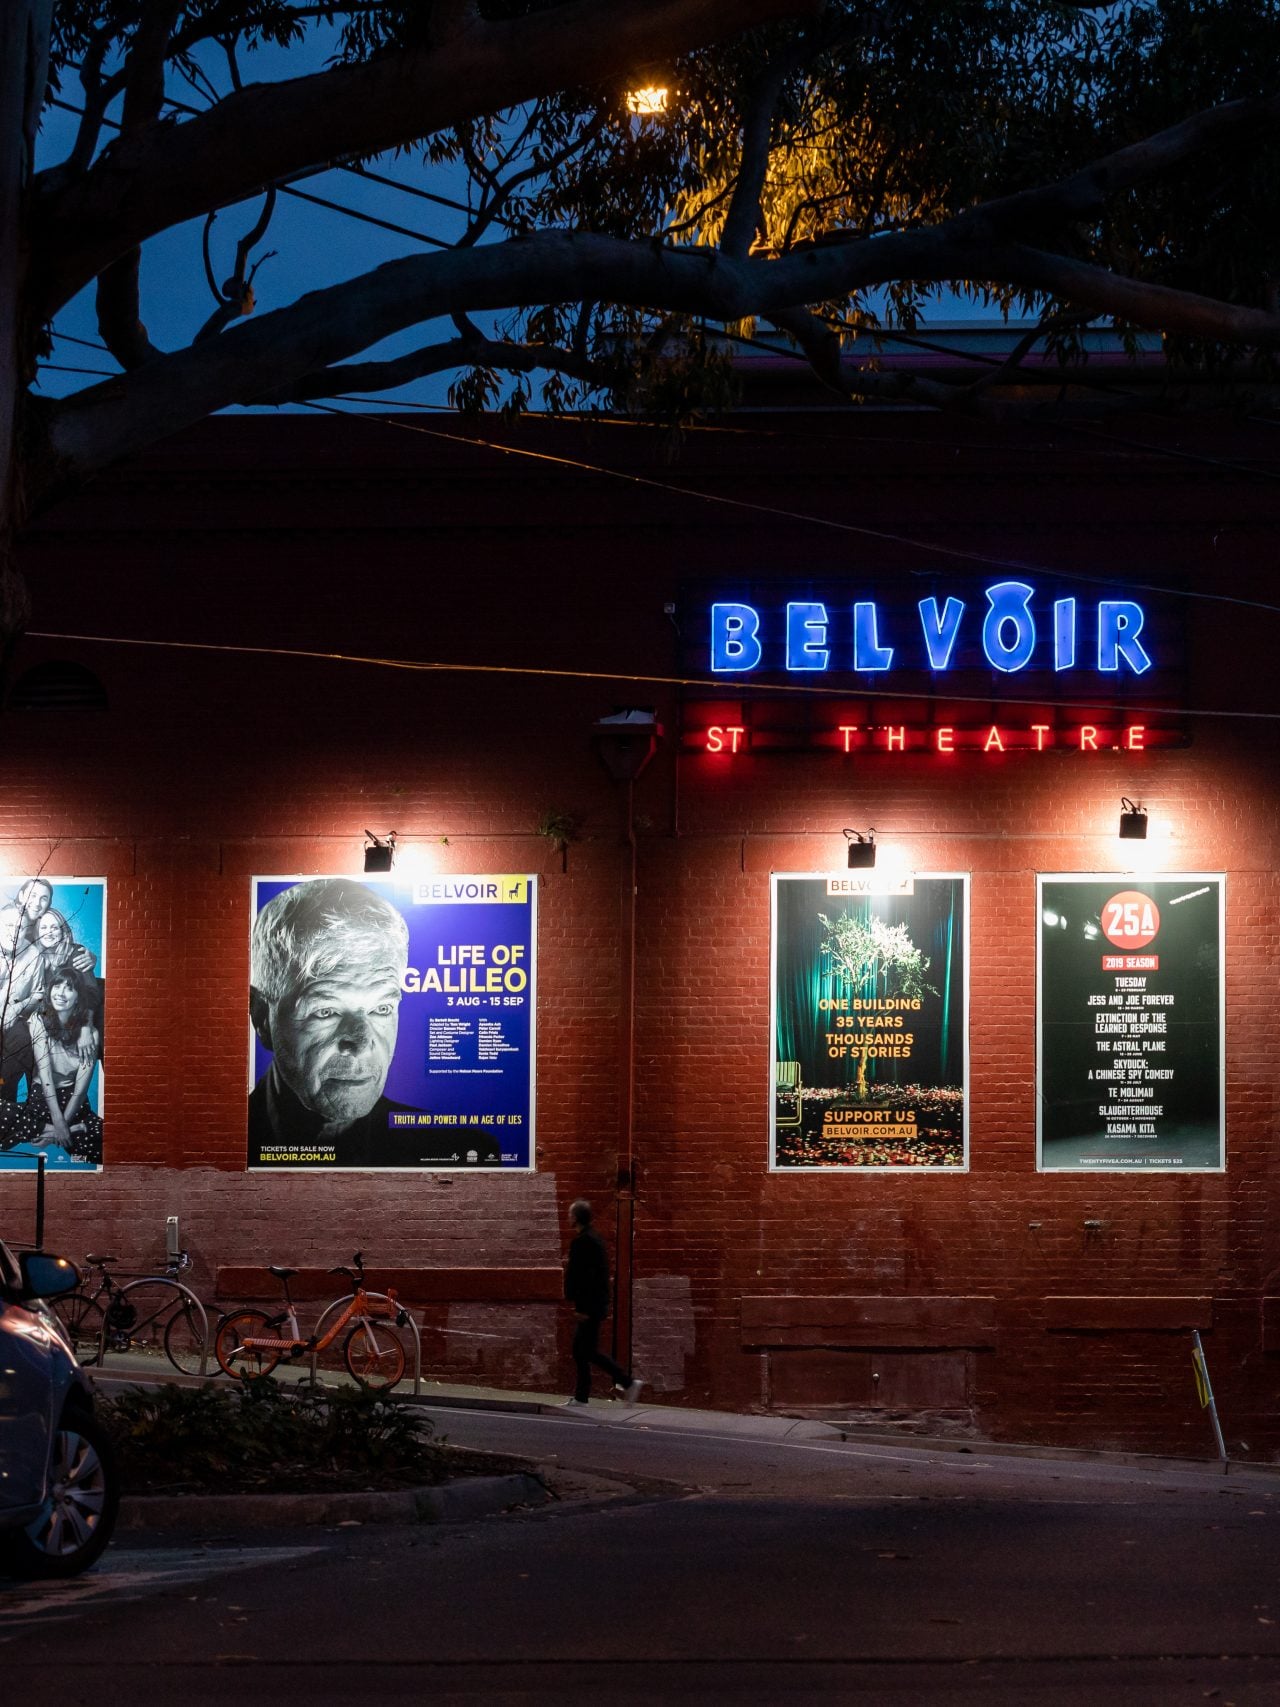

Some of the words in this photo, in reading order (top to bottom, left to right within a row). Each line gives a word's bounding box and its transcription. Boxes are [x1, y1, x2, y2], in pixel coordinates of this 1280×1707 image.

[711, 581, 1152, 675] BELVOIR
[706, 727, 744, 752] ST
[839, 726, 1145, 752] THEATRE
[419, 883, 497, 898] BELVOIR
[1108, 904, 1155, 936] 25A
[438, 946, 485, 965] LIFE
[492, 946, 524, 965] OF
[1106, 958, 1123, 968] 2019
[1126, 958, 1155, 968] SEASON
[401, 968, 527, 992] GALILEO
[1115, 977, 1146, 987] TUESDAY
[448, 997, 454, 1006] 3
[457, 997, 480, 1006] AUG
[490, 997, 500, 1006] 15
[504, 997, 524, 1006] SEP
[819, 999, 848, 1010] ONE
[853, 999, 921, 1010] BUILDING
[1088, 996, 1106, 1005] JESS
[1109, 996, 1123, 1005] AND
[1126, 996, 1140, 1005] JOE
[1142, 996, 1174, 1005] FOREVER
[836, 1017, 853, 1027] 35
[857, 1017, 903, 1027] YEARS
[1096, 1013, 1137, 1023] EXTINCTION
[1140, 1013, 1150, 1023] OF
[1152, 1013, 1166, 1023] THE
[1096, 1024, 1127, 1033] LEARNED
[1130, 1024, 1167, 1033] RESPONSE
[826, 1034, 913, 1044] THOUSANDS
[1096, 1042, 1110, 1051] THE
[1113, 1042, 1140, 1051] ASTRAL
[1143, 1042, 1166, 1051] PLANE
[829, 1047, 846, 1057] OF
[850, 1047, 911, 1057] STORIES
[1114, 1059, 1148, 1069] SKYDUCK:
[1088, 1070, 1093, 1079] A
[1096, 1070, 1125, 1079] CHINESE
[1128, 1070, 1141, 1079] SPY
[1145, 1070, 1174, 1079] COMEDY
[1108, 1088, 1117, 1097] TE
[1121, 1088, 1154, 1097] MOLIMAU
[1099, 1106, 1163, 1115] SLAUGHTERHOUSE
[394, 1115, 415, 1125] TRUTH
[418, 1115, 431, 1125] AND
[434, 1115, 457, 1125] POWER
[460, 1115, 466, 1125] IN
[470, 1115, 478, 1125] AN
[481, 1115, 494, 1125] AGE
[496, 1115, 505, 1125] OF
[508, 1115, 522, 1125] LIES
[824, 1111, 891, 1122] SUPPORT
[895, 1111, 915, 1122] US
[826, 1127, 913, 1135] BELVOIR.COM.AU
[1107, 1124, 1136, 1133] KASAMA
[1140, 1124, 1155, 1133] KITA
